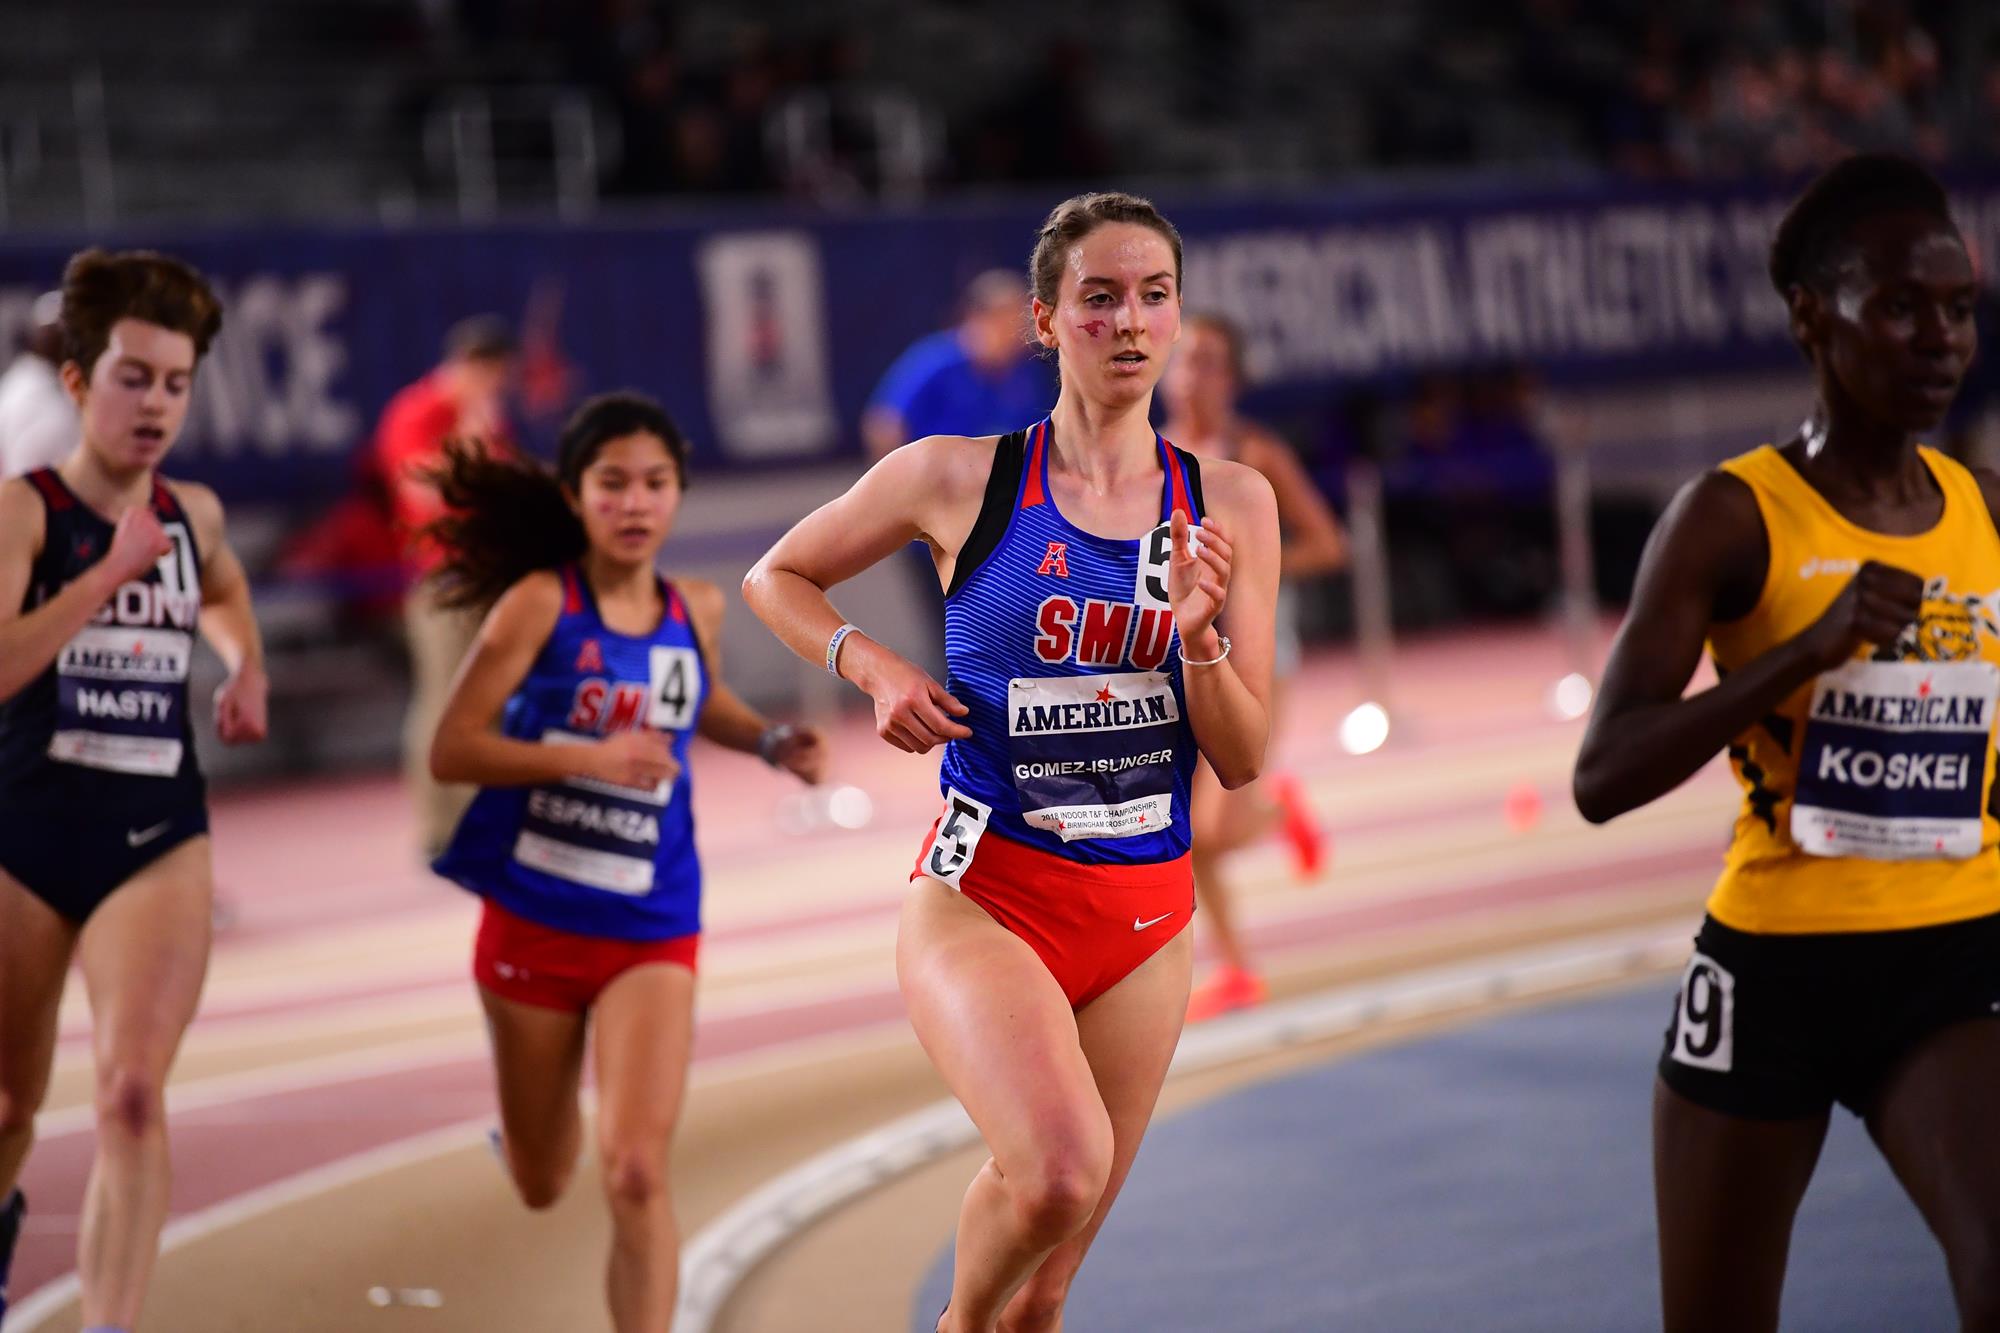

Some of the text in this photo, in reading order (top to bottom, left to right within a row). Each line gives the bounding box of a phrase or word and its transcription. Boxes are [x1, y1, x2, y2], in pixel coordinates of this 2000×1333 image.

[1036, 542, 1070, 578] A
[1145, 526, 1190, 603] 5
[1034, 594, 1176, 671] SMU
[76, 686, 173, 723] HASTY
[567, 676, 660, 734] SM
[661, 658, 687, 717] 4
[1818, 689, 1984, 726] AMERICAN
[1015, 694, 1169, 733] AMERICAN
[1015, 748, 1173, 780] GOMEZ-ISLINGER
[1817, 744, 1971, 790] KOSKEI
[527, 787, 660, 846] ESPARZA
[1041, 800, 1158, 821] 2018 INDOOR T&F CHAMPIONSHIPS
[1067, 816, 1138, 829] BIRMINGHAM CROSSPLEX
[931, 796, 979, 877] 5
[1684, 964, 1723, 1058] 9
